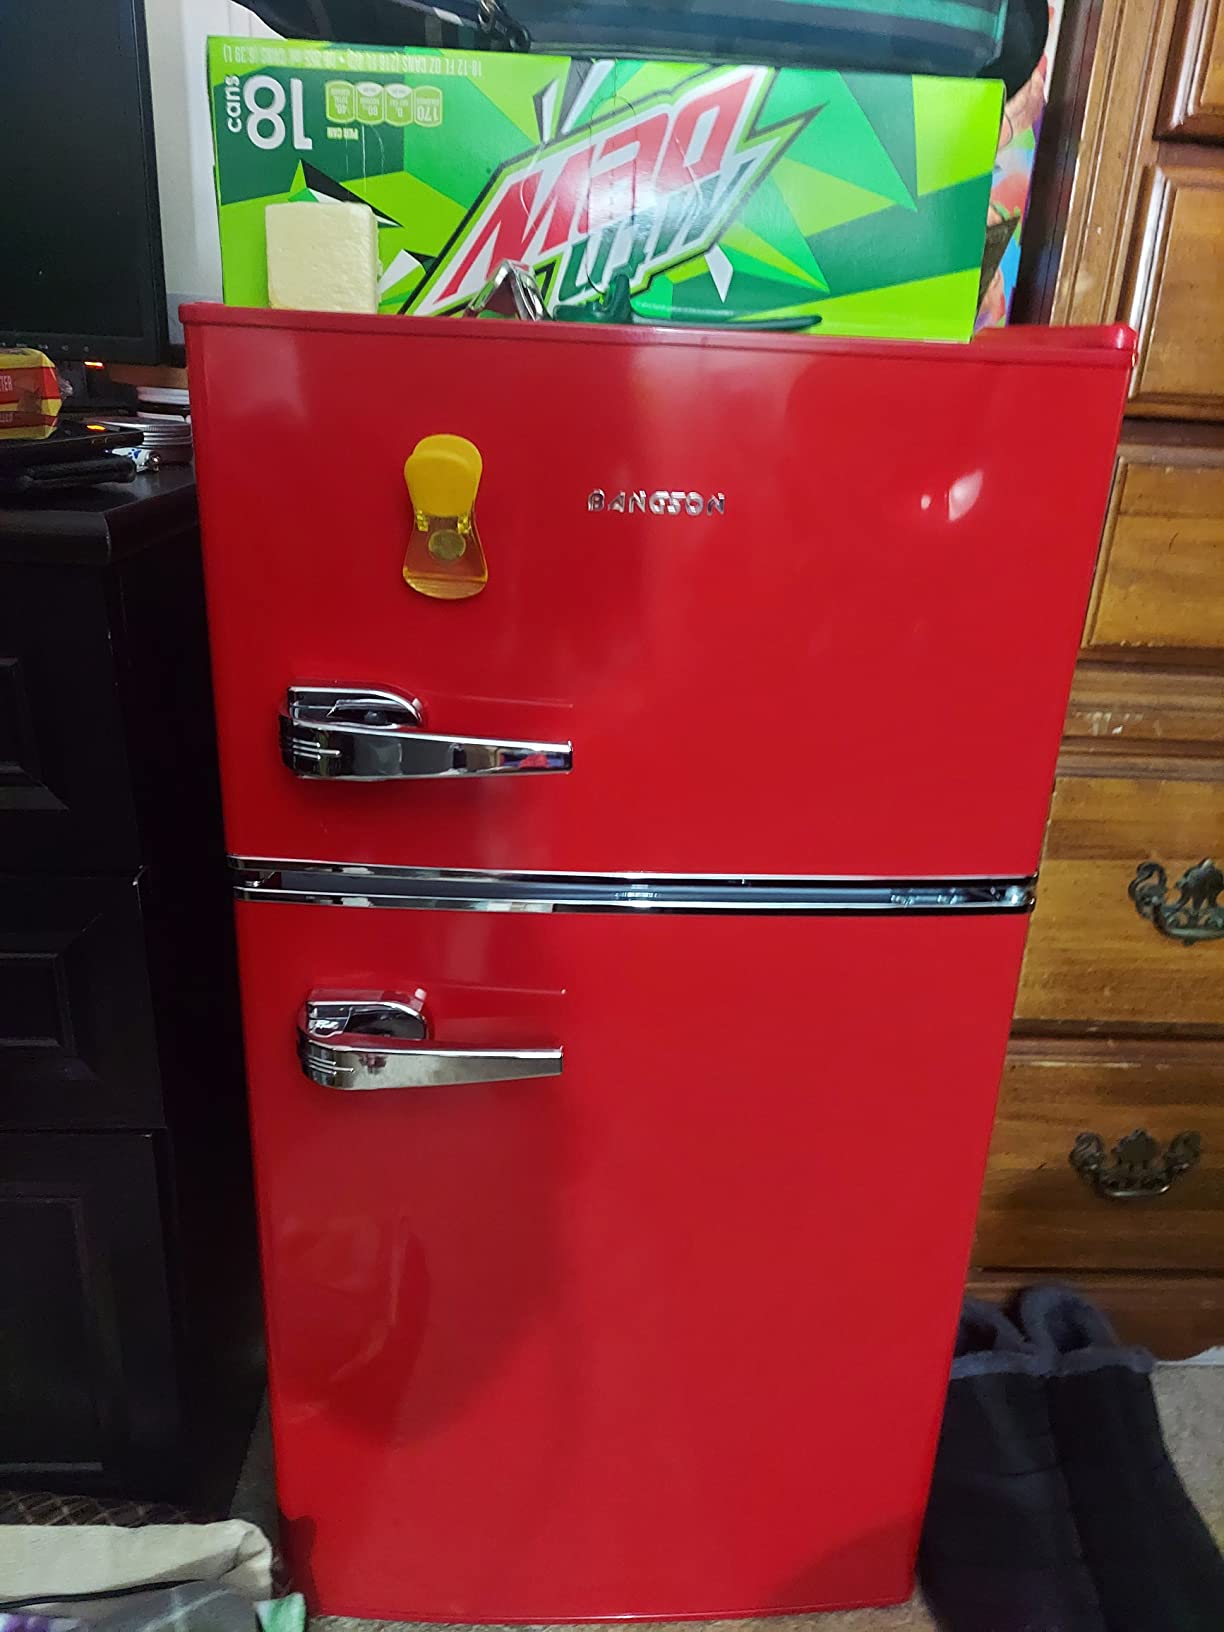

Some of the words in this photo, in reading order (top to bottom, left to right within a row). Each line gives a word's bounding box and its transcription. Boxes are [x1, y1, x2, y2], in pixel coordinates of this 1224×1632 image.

[402, 55, 427, 74] CANS
[429, 58, 441, 74] OZ
[445, 58, 455, 75] FL
[224, 74, 242, 133] cans
[243, 75, 312, 150] 18
[417, 105, 439, 122] 170
